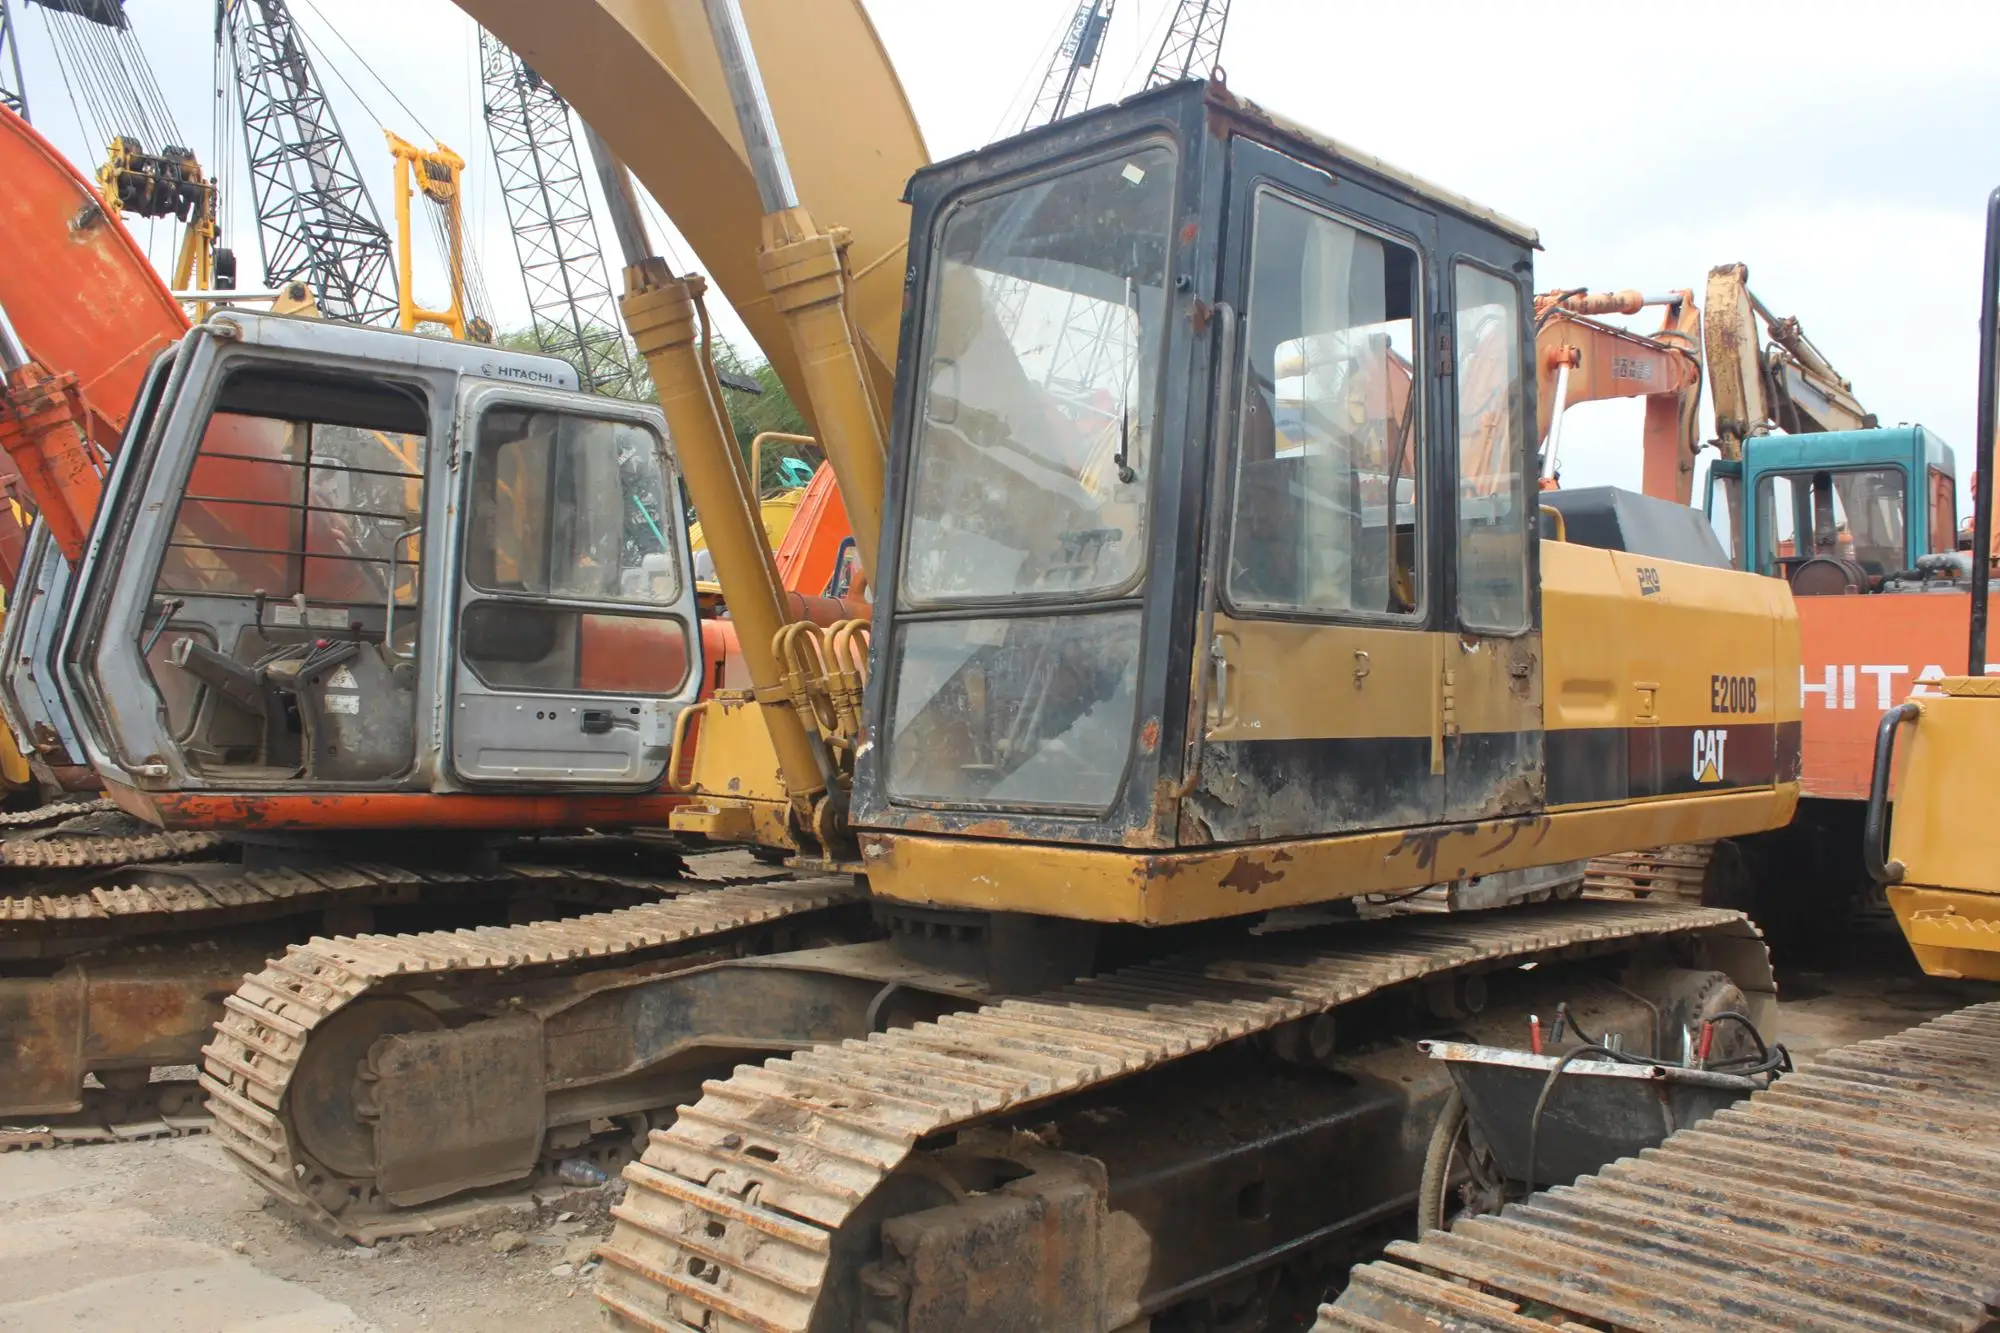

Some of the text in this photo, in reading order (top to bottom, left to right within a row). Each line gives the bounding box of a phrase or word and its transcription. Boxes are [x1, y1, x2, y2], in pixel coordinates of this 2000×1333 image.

[498, 366, 552, 383] HITACHI
[1711, 674, 1757, 714] E200B
[1800, 664, 2000, 710] HITA
[1692, 729, 1728, 782] CAT
